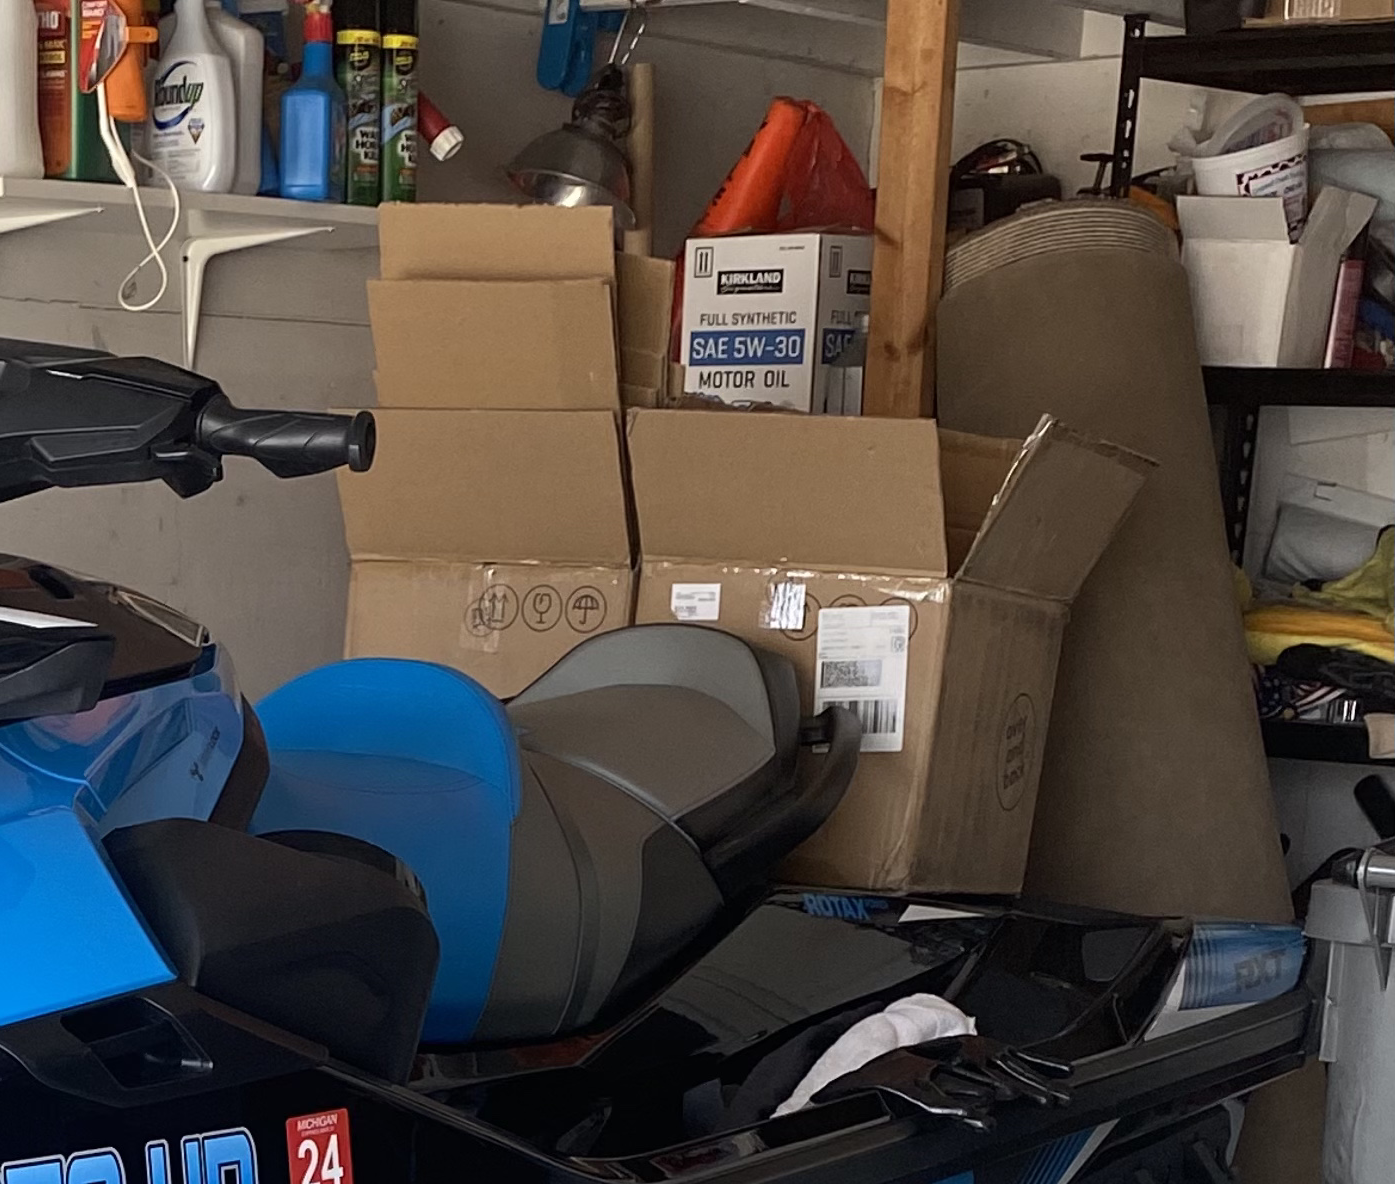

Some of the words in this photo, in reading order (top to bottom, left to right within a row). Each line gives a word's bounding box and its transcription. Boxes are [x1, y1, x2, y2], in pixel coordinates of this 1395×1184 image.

[720, 271, 781, 285] KIRKLAND
[700, 313, 728, 326] FULL
[731, 311, 797, 325] SYNTHETIC
[692, 337, 729, 359] SAE
[734, 335, 801, 358] 5W-30
[699, 370, 755, 389] MOTOR
[764, 369, 790, 388] OIL
[803, 893, 870, 921] ROTAX
[297, 1114, 338, 1131] MICHIGAN
